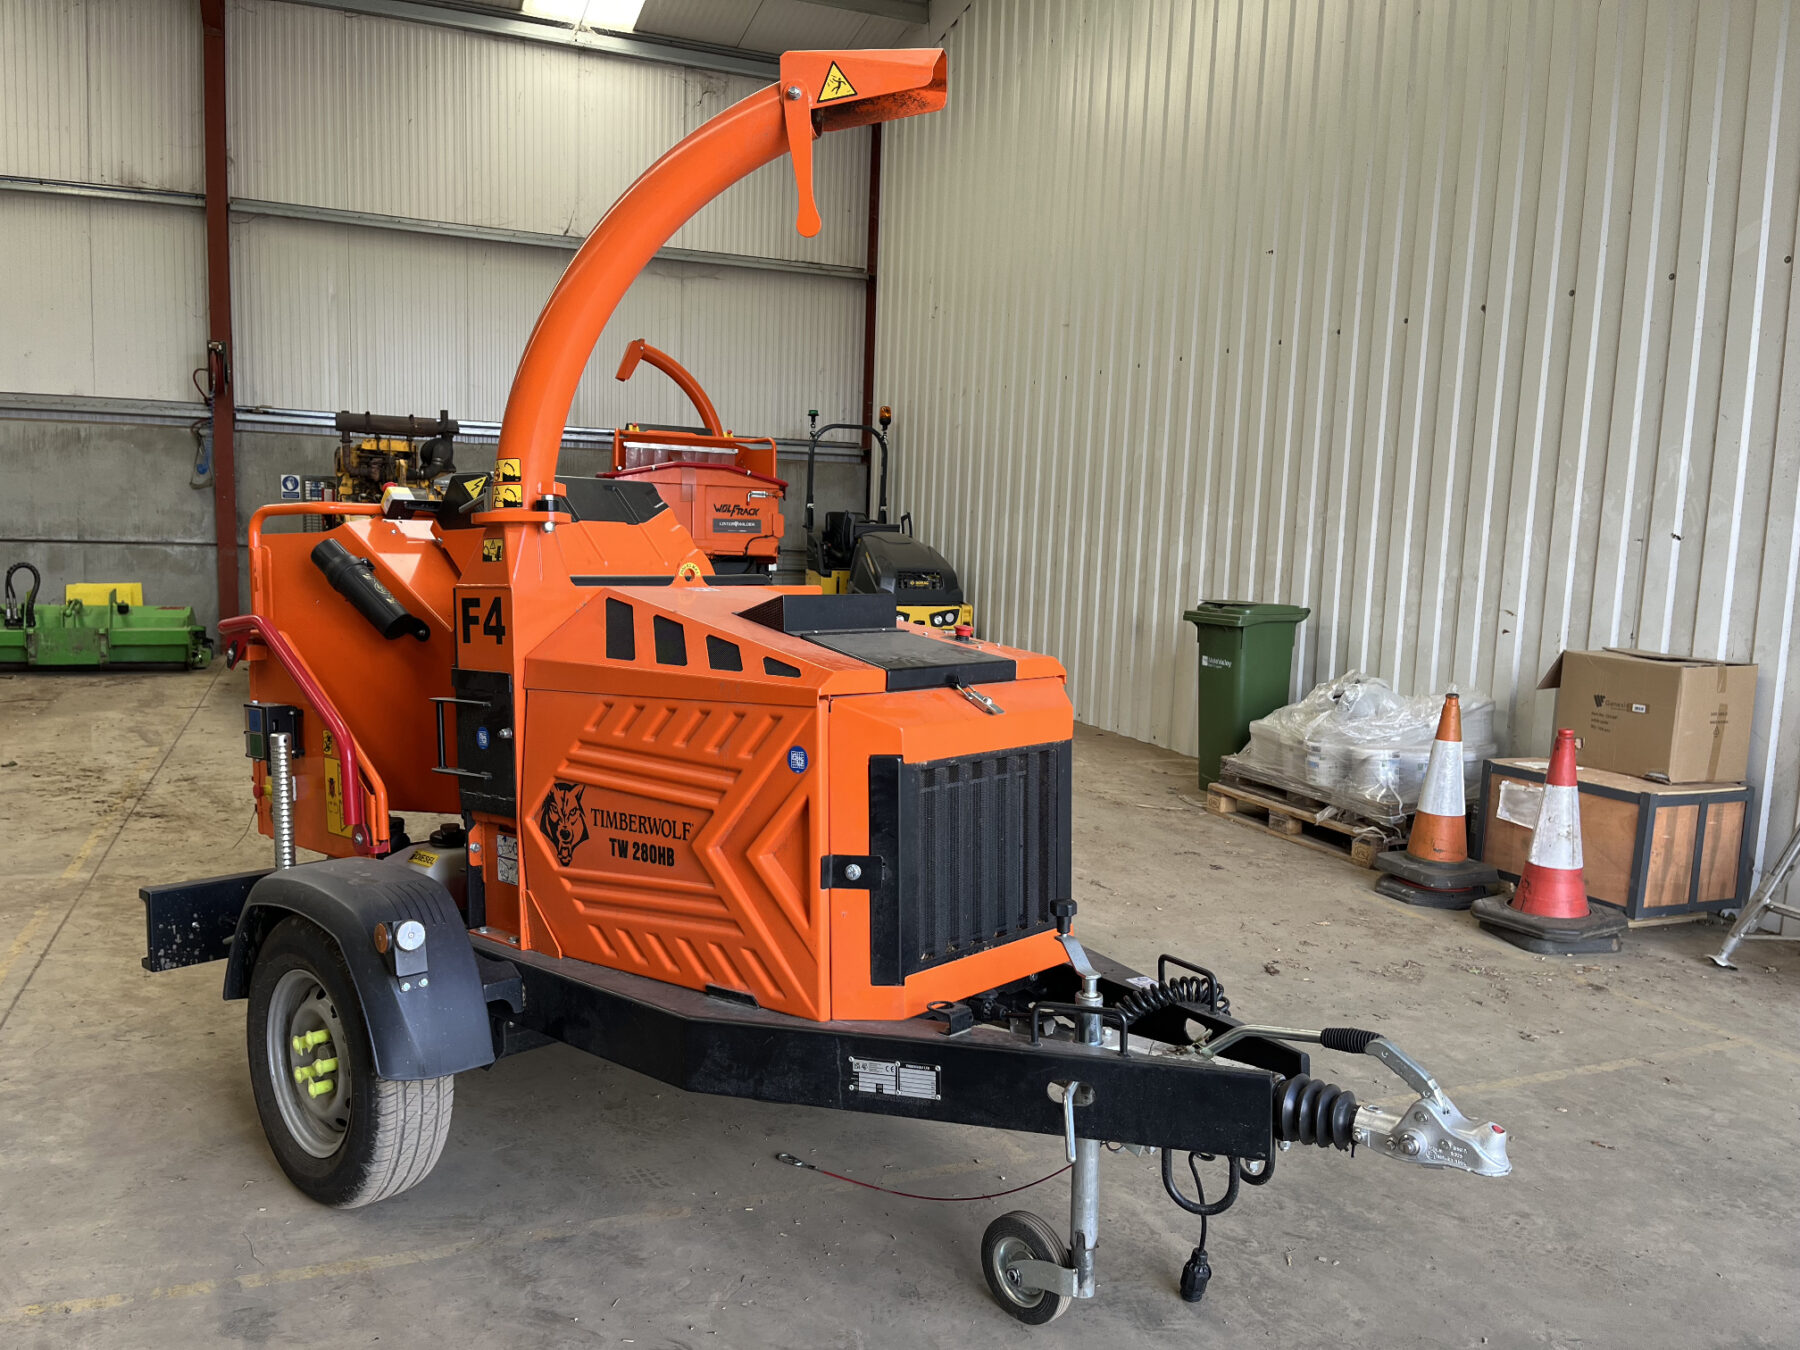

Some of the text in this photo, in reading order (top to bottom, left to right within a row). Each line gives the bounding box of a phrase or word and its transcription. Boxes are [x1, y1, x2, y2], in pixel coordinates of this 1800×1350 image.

[713, 503, 760, 517] WOLFTRACK
[461, 596, 506, 645] F4
[590, 808, 692, 841] TIMBERWOLF
[609, 838, 675, 867] TW 280HB
